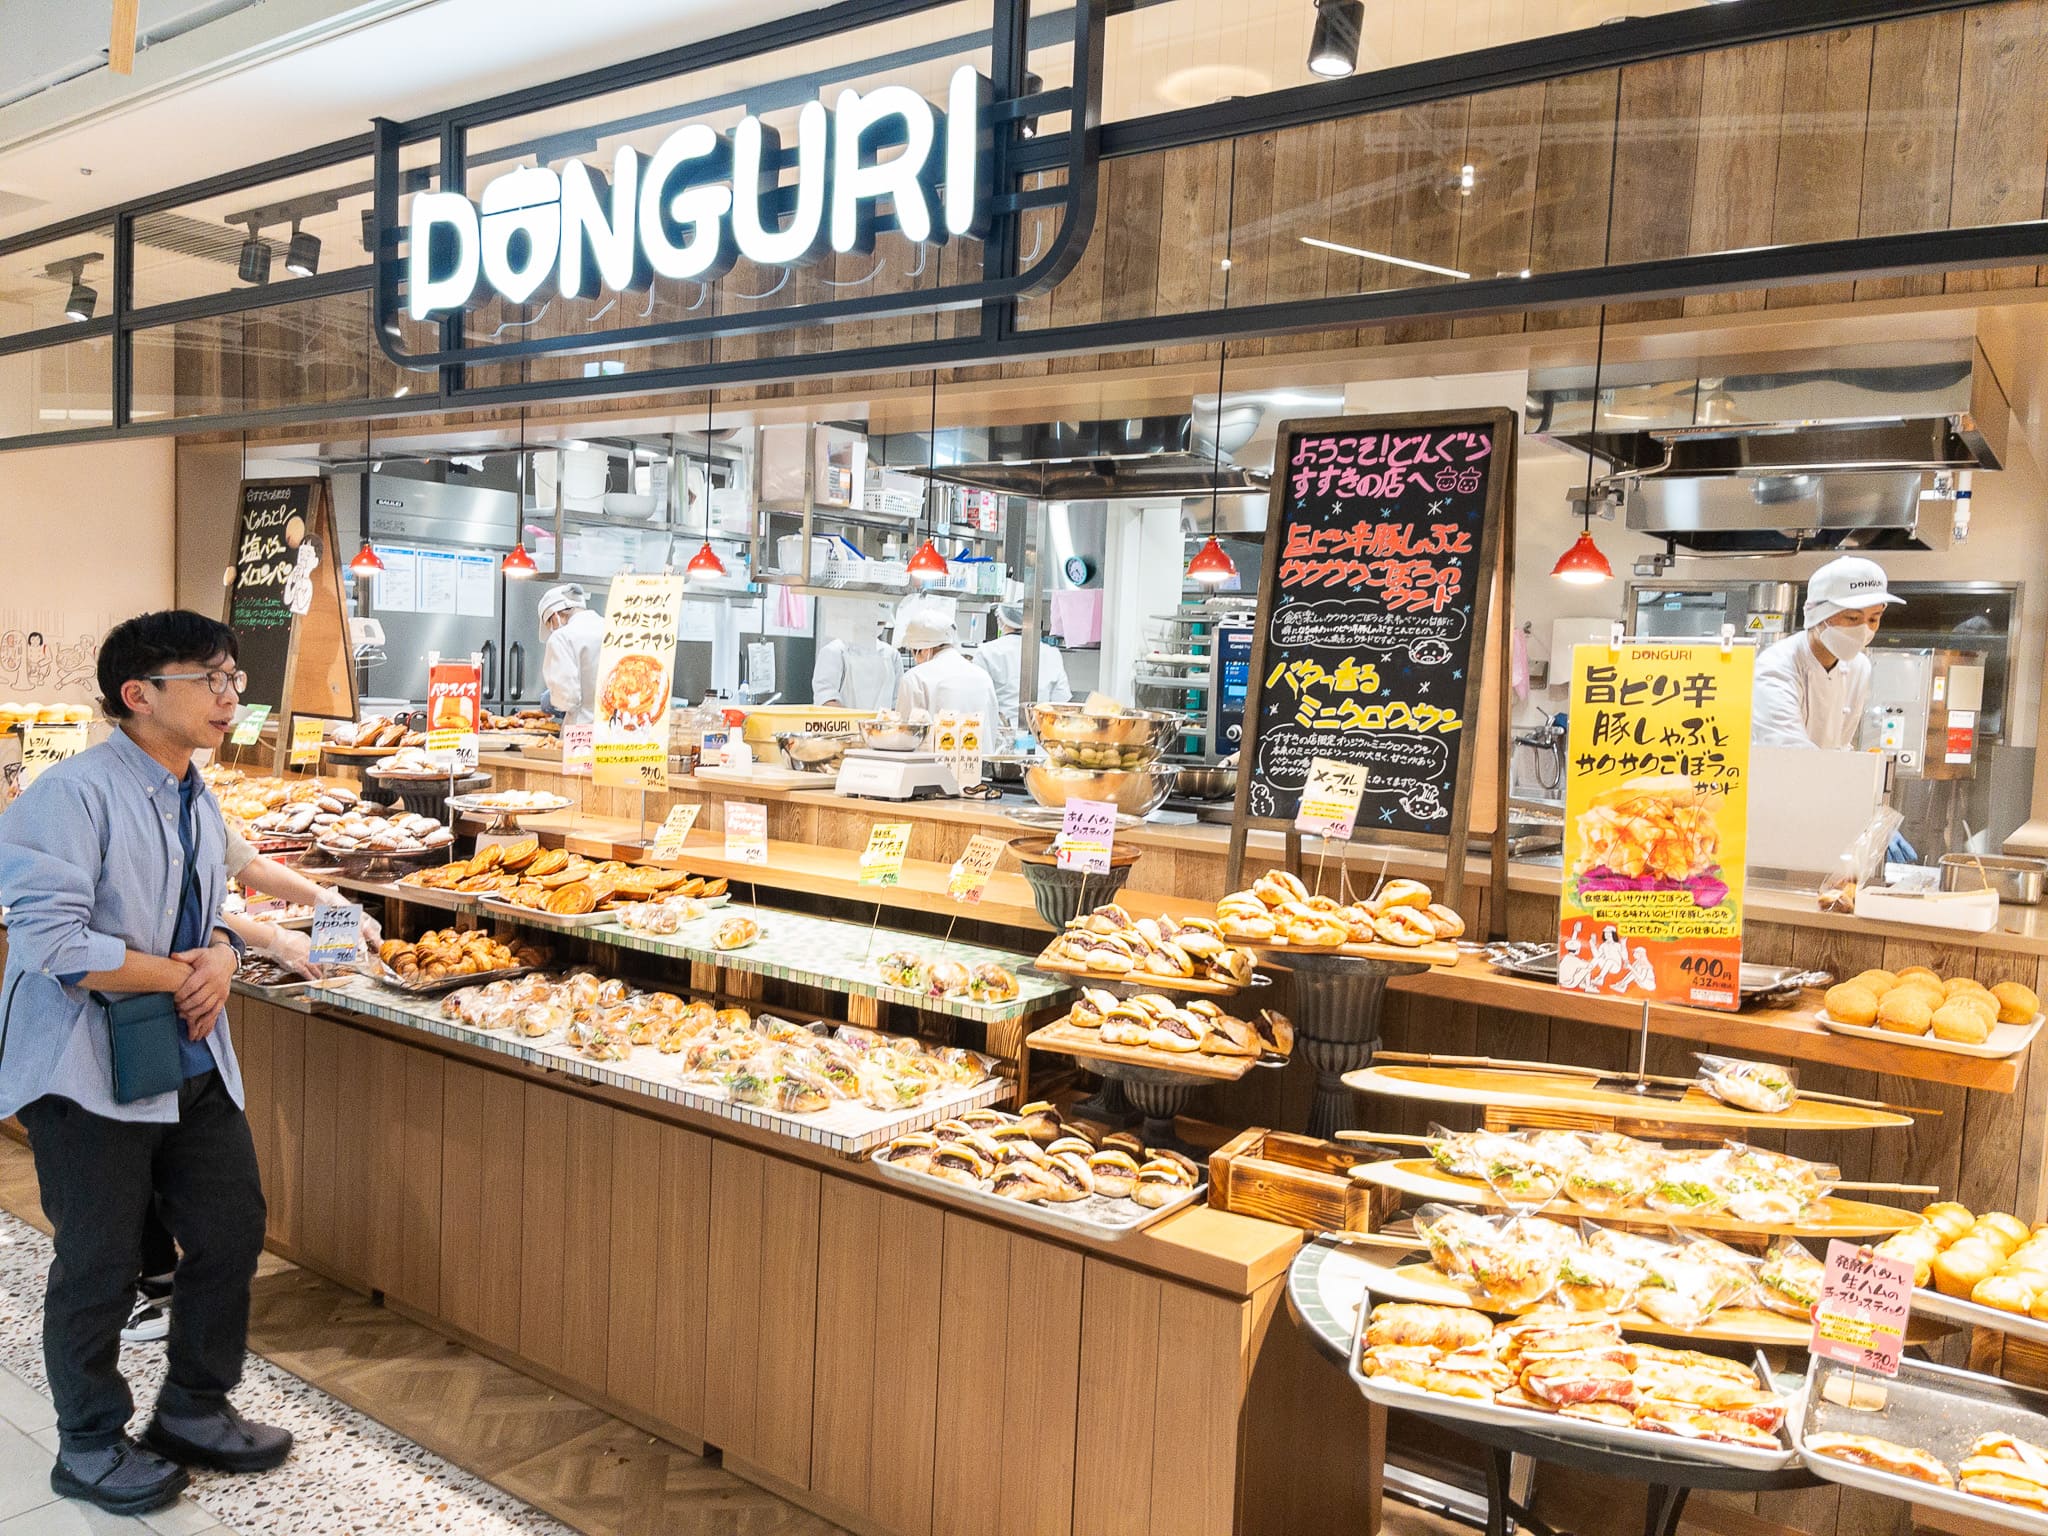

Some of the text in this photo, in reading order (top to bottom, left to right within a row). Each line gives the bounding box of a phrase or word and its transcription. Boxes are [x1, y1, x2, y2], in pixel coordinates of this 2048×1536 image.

[408, 65, 978, 322] DONGURI
[1291, 433, 1492, 466] ようこそ!どんぐり
[1292, 467, 1435, 499] すすきの店へ
[1283, 520, 1472, 557] 旨ピリ辛豚しゃぶと
[1279, 559, 1462, 588] サクサクごぼうの
[1380, 585, 1459, 612] サンド
[1632, 650, 1692, 660] DONGURI
[430, 682, 477, 697] パンスイス
[1265, 656, 1380, 699] バター香る
[1585, 666, 1717, 708] 旨ピリ辛
[805, 721, 850, 732] DONGURI
[1295, 694, 1463, 734] ミニクロワッサン
[1593, 710, 1729, 747] 豚しゃぶと
[1576, 749, 1740, 778] サクサクごぼうの
[1694, 781, 1739, 796] サンド
[1680, 955, 1732, 981] 400円
[1835, 1254, 1906, 1287] 発酵バターと
[1824, 1286, 1906, 1317] チーズリュスティック
[1841, 1272, 1899, 1301] 生ハムの
[1864, 1349, 1896, 1369] 330円
